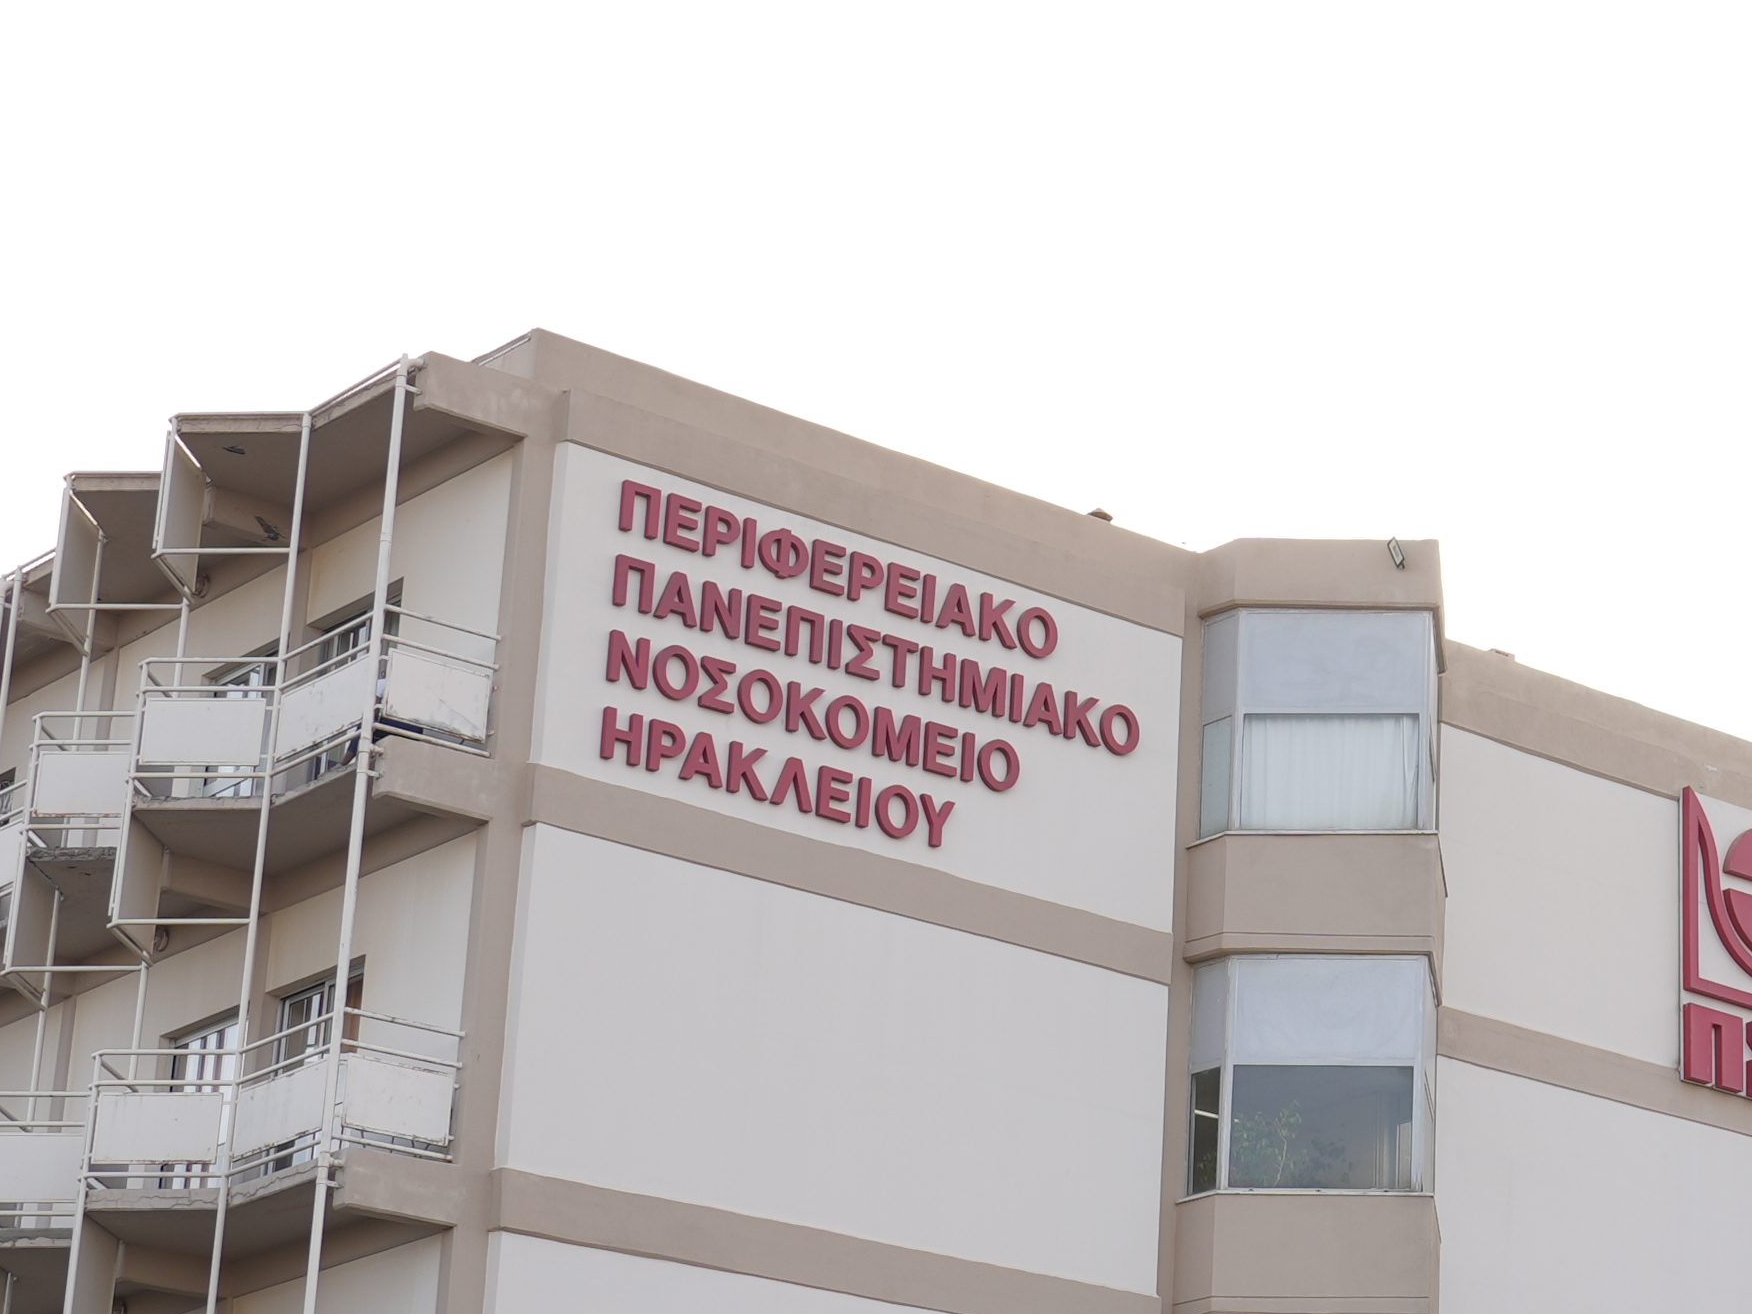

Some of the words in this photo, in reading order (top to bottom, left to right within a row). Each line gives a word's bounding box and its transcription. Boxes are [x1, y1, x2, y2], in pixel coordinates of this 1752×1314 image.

[618, 478, 1058, 659] ΠΕΡΙΦΕΡΕΙΑΚΟ
[606, 629, 1020, 792] ΝΟΣΟΚΟΜΕΙΟ
[612, 553, 1140, 757] ΠΑΝΕΠΙΣΤΗΜΙΑΚΟ
[599, 705, 956, 848] ΗΡΑΚΛΕΙΟΥ
